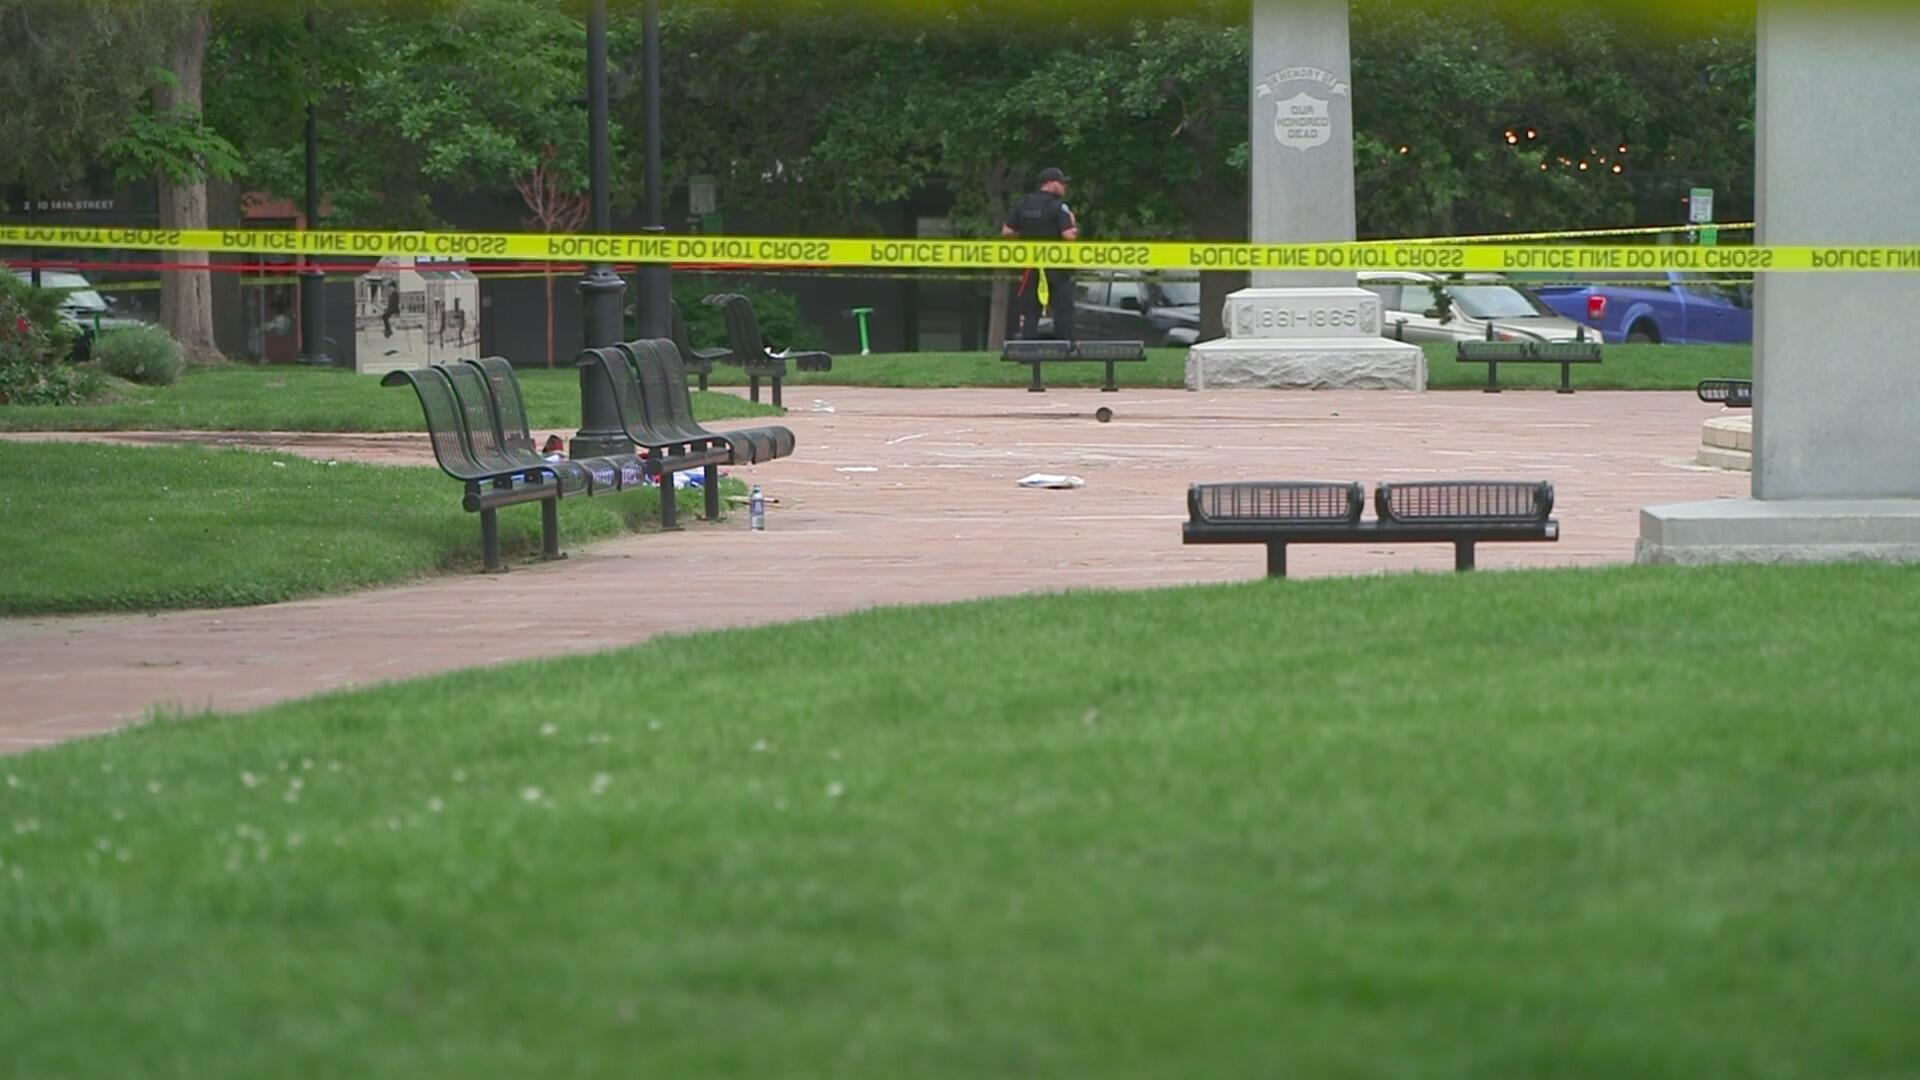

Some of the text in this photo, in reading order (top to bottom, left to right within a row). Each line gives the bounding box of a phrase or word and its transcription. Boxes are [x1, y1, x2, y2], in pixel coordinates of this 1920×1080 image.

[1291, 105, 1314, 115] OUR
[1277, 117, 1329, 127] HONORED
[1288, 129, 1318, 139] DEAD
[75, 199, 114, 210] STREET
[1255, 308, 1358, 328] 1861-1865
